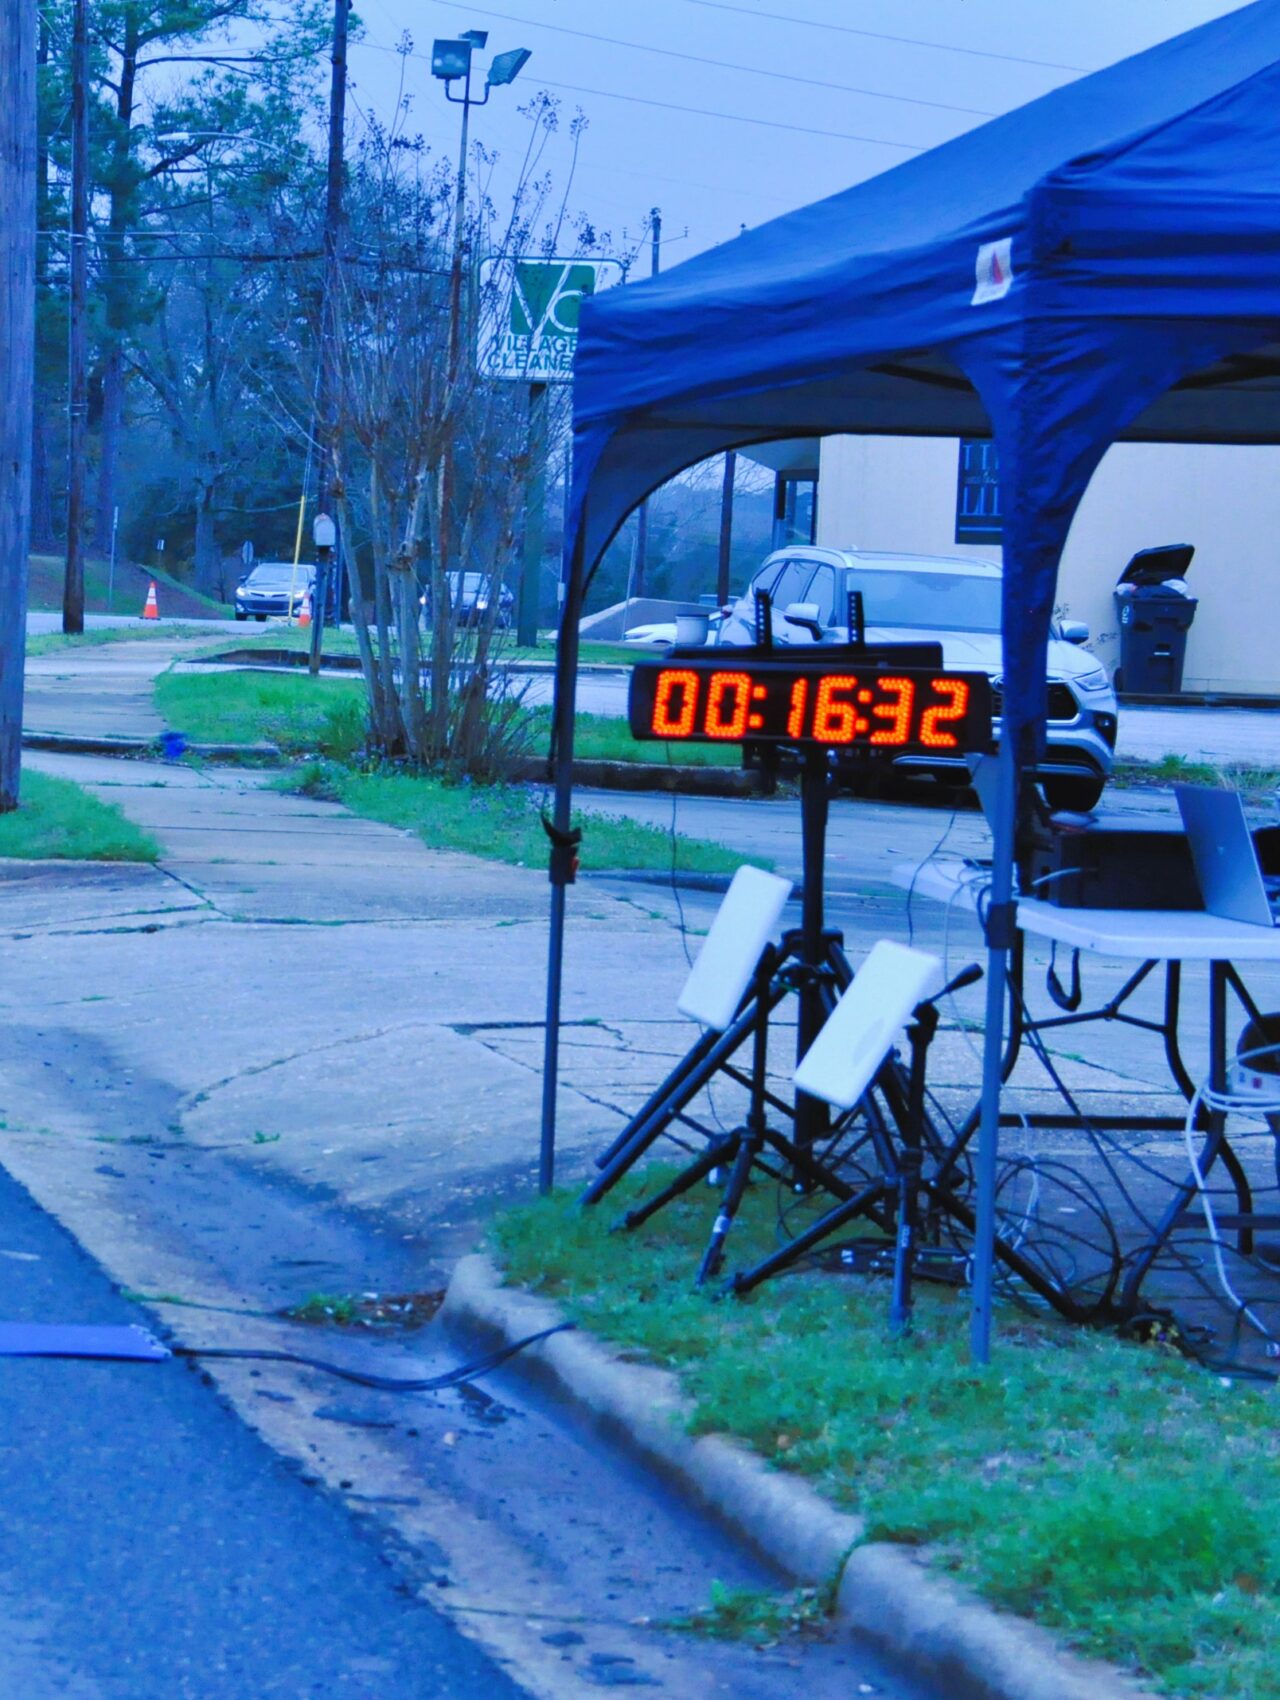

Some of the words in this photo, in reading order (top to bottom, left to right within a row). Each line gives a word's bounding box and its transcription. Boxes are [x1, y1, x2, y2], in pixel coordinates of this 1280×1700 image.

[492, 335, 578, 353] VILLAGE
[487, 352, 572, 371] CLEANE
[651, 669, 969, 748] 00:16:32
